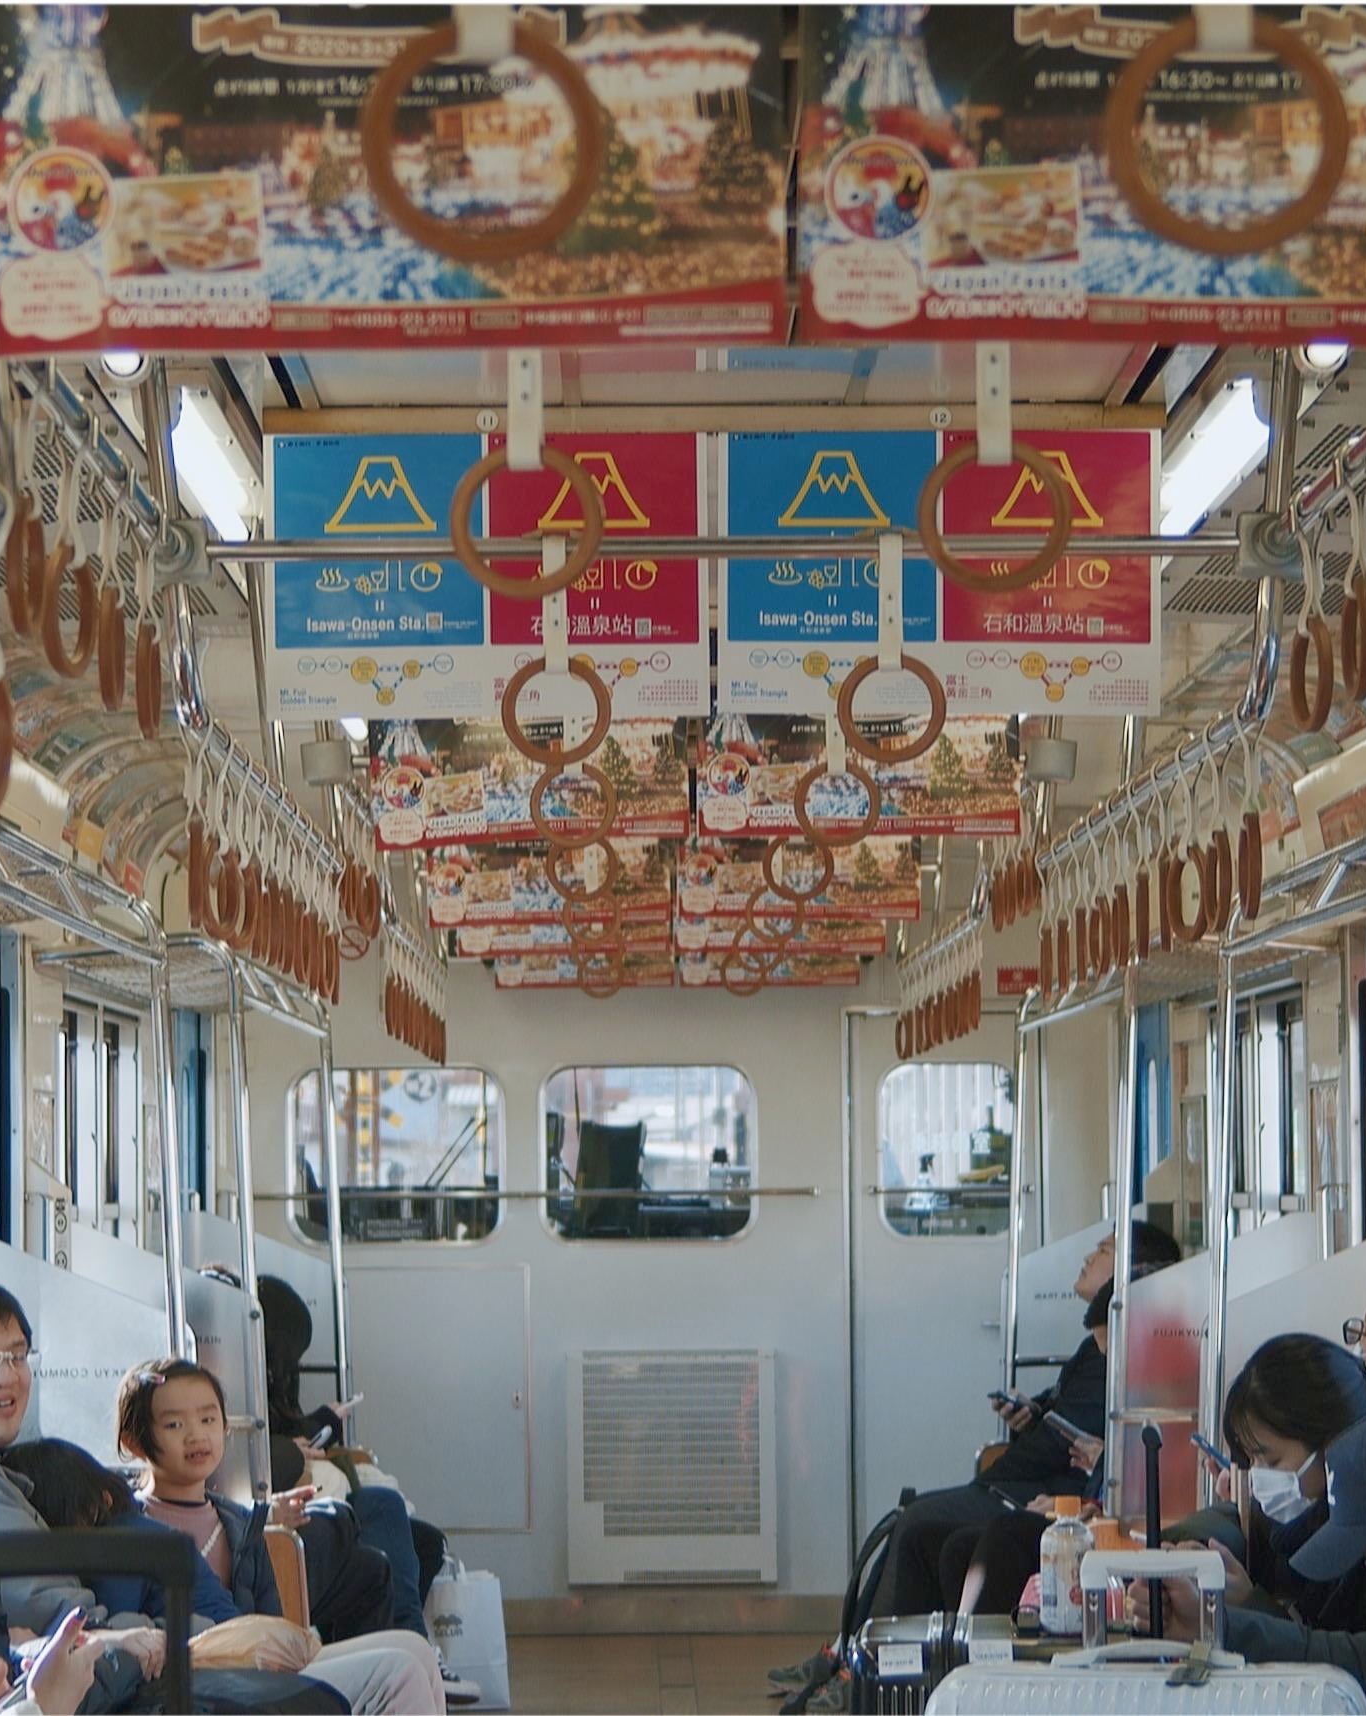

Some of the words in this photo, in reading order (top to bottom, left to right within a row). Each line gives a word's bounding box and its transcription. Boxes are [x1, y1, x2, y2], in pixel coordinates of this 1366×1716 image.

[483, 415, 493, 426] 11
[935, 412, 947, 424] 12
[307, 616, 395, 633] Isawa-Onsen
[399, 616, 425, 631] Sta.
[530, 613, 633, 637] 石溫泉站
[759, 610, 847, 626] Isawa-Onsen
[851, 610, 877, 626] Sta.
